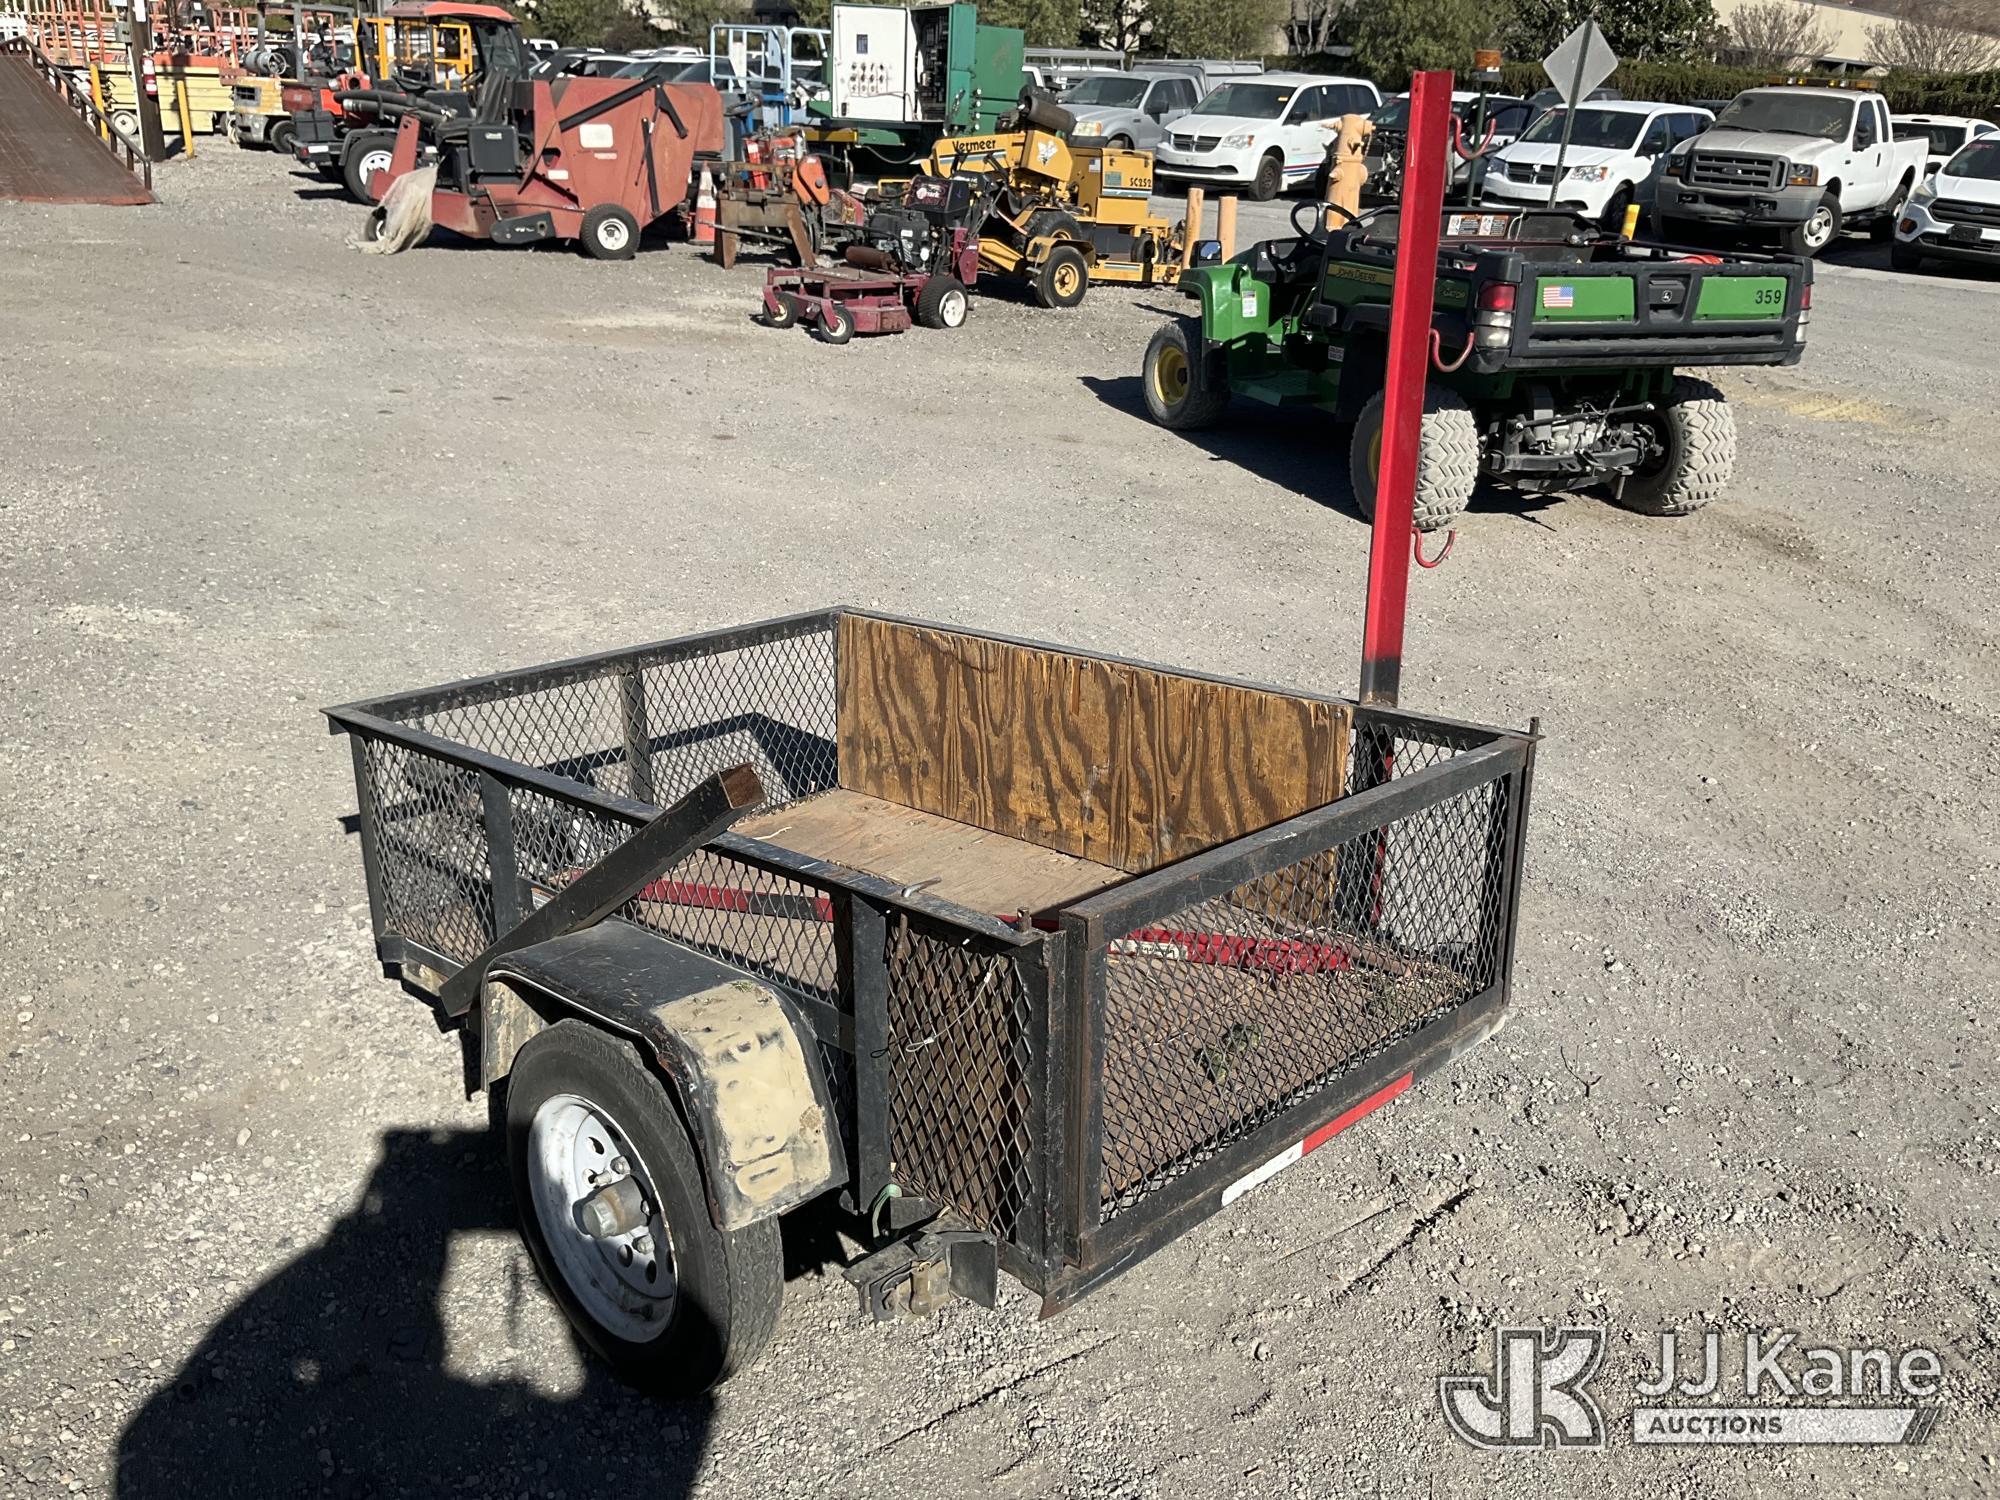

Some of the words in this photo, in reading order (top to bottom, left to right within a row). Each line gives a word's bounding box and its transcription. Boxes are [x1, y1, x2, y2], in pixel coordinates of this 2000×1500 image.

[952, 140, 996, 152] Vermeer
[1130, 177, 1152, 188] SC252
[1335, 268, 1355, 279] JOHN
[1355, 269, 1377, 282] DEERE
[1755, 289, 1782, 304] 359
